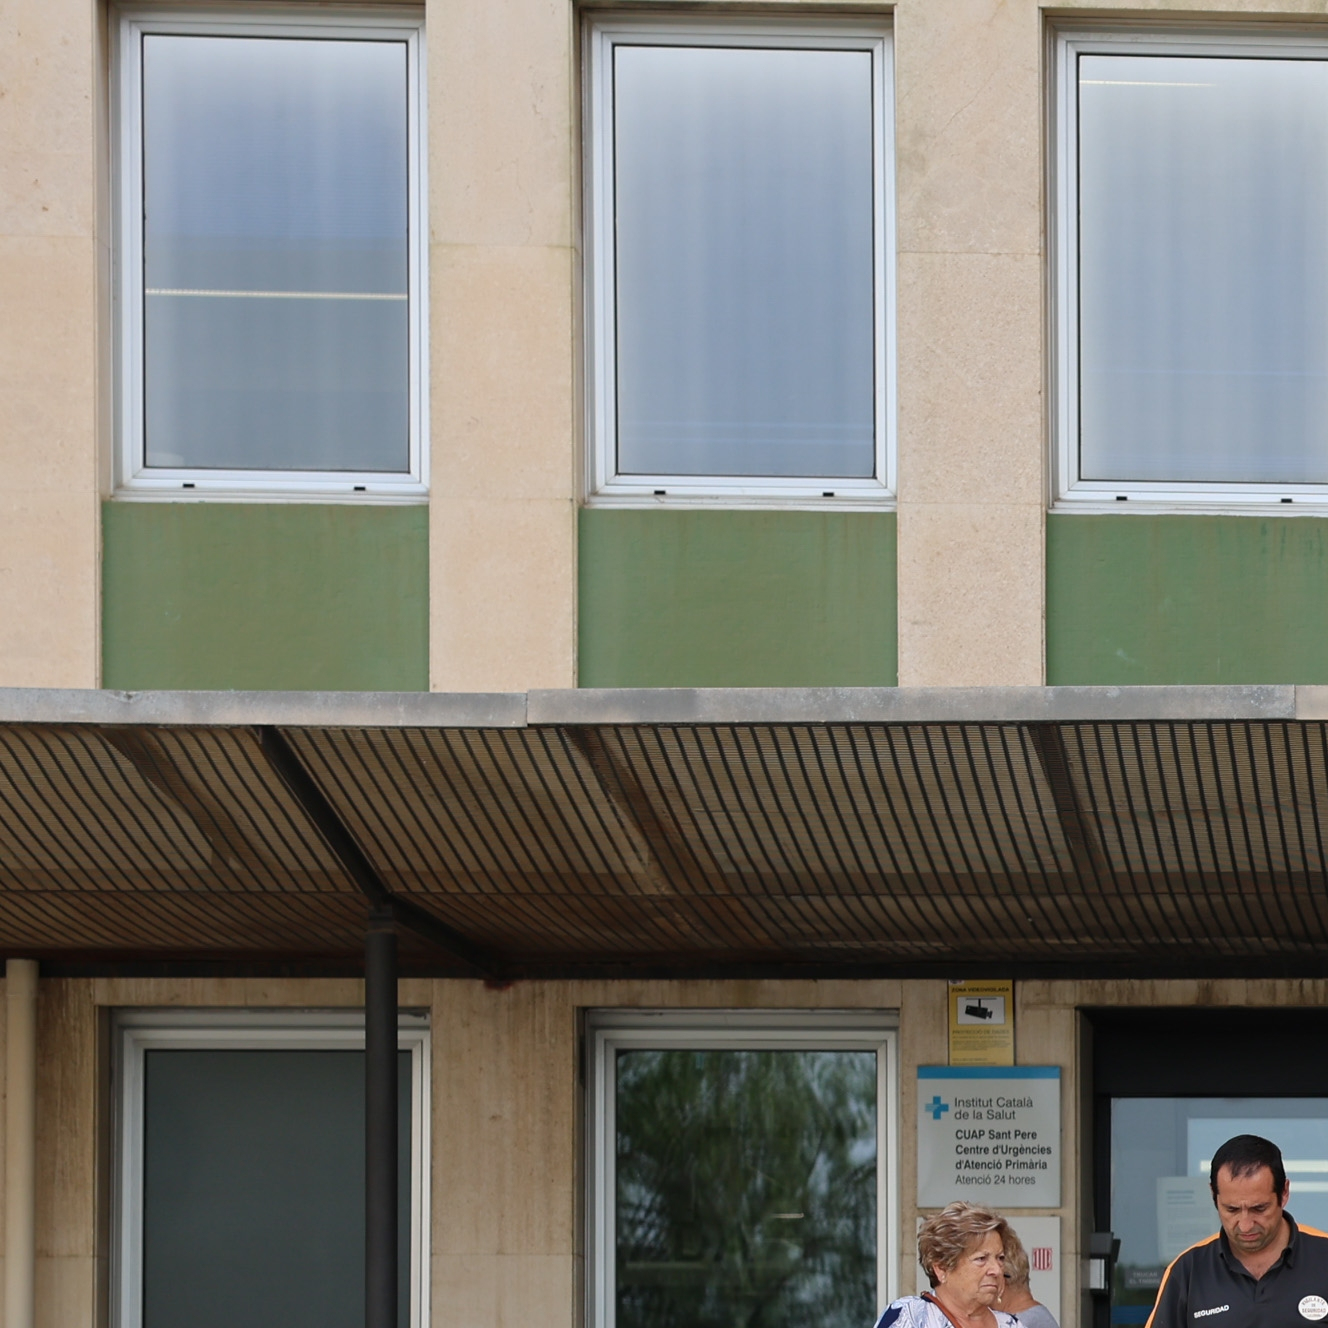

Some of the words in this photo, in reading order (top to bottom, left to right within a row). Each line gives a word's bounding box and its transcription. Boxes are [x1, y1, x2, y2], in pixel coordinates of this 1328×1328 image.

[954, 1097, 993, 1108] Institut
[996, 1096, 1033, 1108] Català
[954, 1109, 969, 1120] de
[973, 1109, 983, 1120] la
[986, 1109, 1016, 1120] Salut
[955, 1129, 985, 1140] CUAP
[988, 1129, 1011, 1140] Sant
[1014, 1129, 1037, 1140] Pere
[955, 1144, 990, 1155] Centre
[992, 1144, 1052, 1158] d'Urgències
[955, 1159, 1002, 1170] d'Atenció
[1005, 1159, 1047, 1170] Primària
[955, 1174, 992, 1185] Atenció
[993, 1174, 1006, 1185] 24
[1008, 1174, 1036, 1185] hores
[1193, 1304, 1230, 1319] SEGURIDAD
